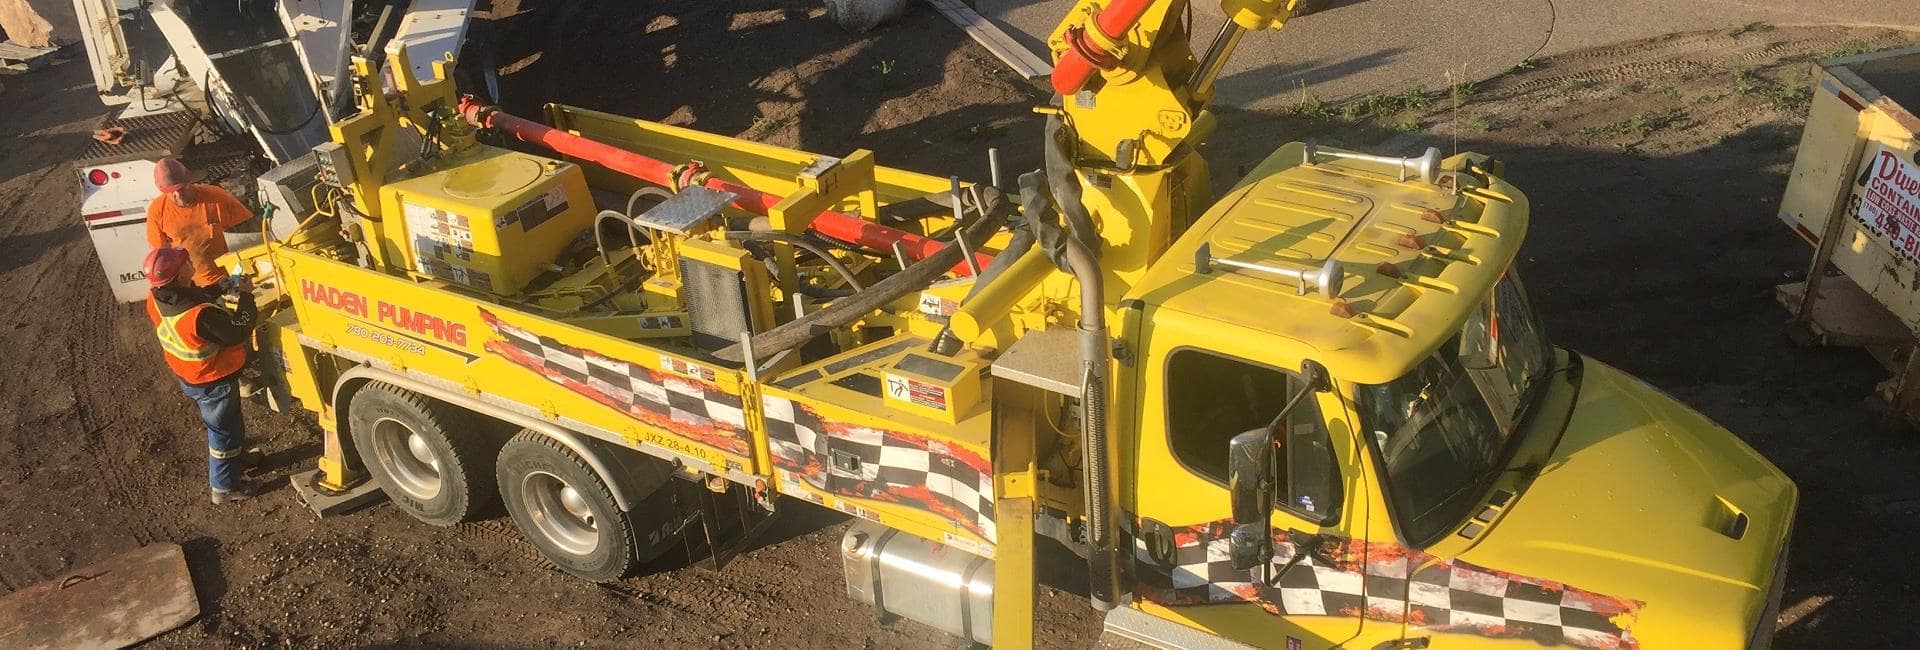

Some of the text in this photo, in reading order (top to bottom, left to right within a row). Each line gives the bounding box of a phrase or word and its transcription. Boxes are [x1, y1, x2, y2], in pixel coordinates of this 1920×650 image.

[302, 279, 467, 347] HADEN PUMPING
[346, 323, 425, 355] 780-203-7734
[645, 432, 706, 459] JXZ 28-4.10
